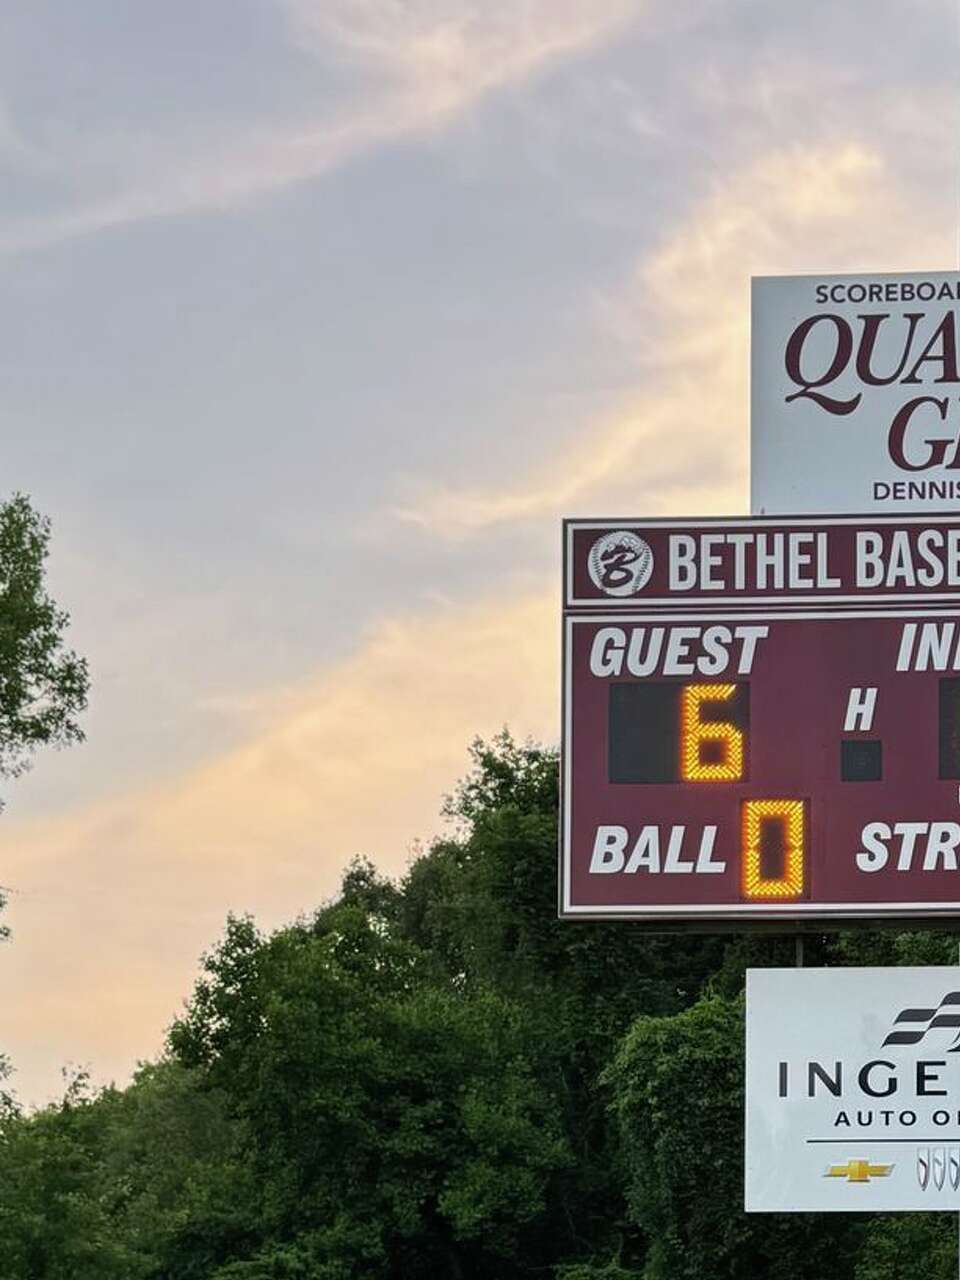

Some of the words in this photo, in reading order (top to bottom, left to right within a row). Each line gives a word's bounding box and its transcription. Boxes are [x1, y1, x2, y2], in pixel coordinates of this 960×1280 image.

[668, 531, 842, 591] BETHEL
[589, 625, 769, 677] GUEST
[681, 682, 744, 783] 6
[843, 687, 878, 731] H
[589, 825, 726, 874] BALL
[742, 799, 805, 897] 0
[834, 1109, 917, 1127] AUTO
